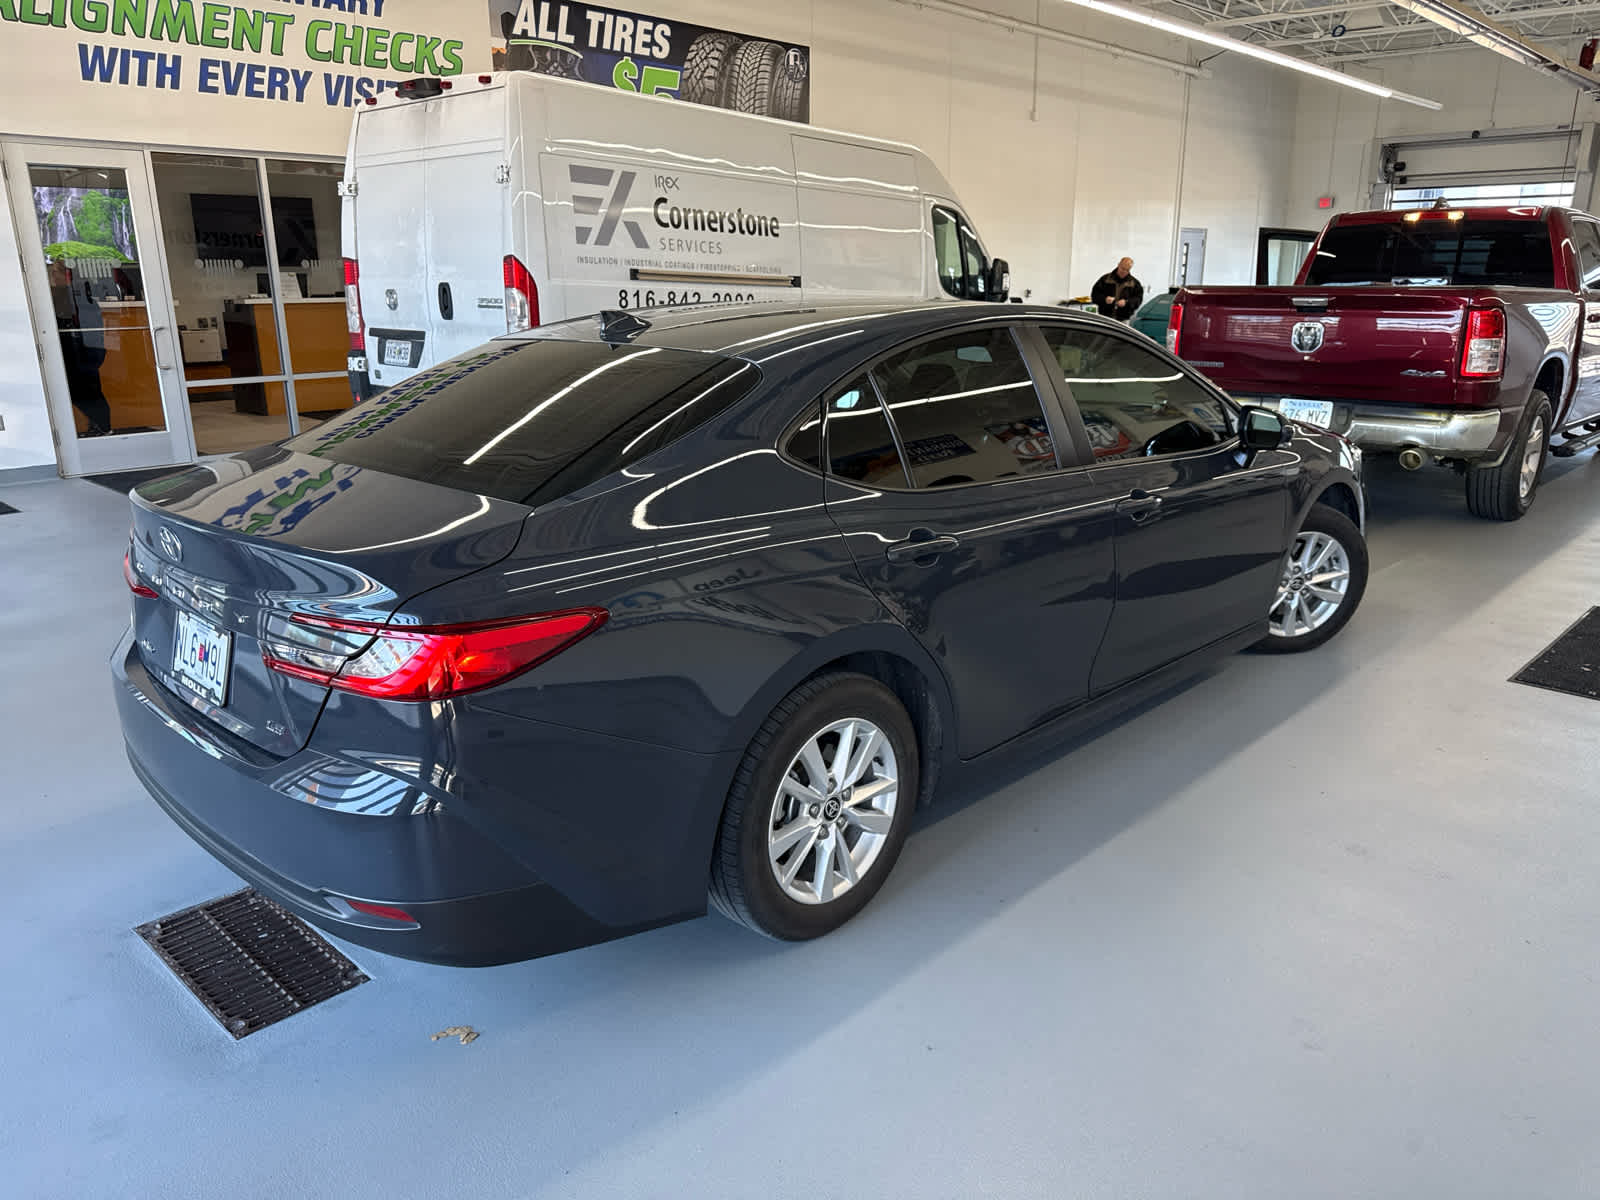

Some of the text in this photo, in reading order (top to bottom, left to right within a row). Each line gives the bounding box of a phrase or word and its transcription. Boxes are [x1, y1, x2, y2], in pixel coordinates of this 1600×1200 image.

[0, 0, 464, 76] LIGNMENT CHECKS
[512, 0, 672, 59] ALL TIRES
[78, 43, 401, 107] WITH EVERY VIS
[653, 196, 780, 238] Cornerstone
[660, 237, 722, 255] SERVICES
[181, 674, 207, 698] MOLLE
